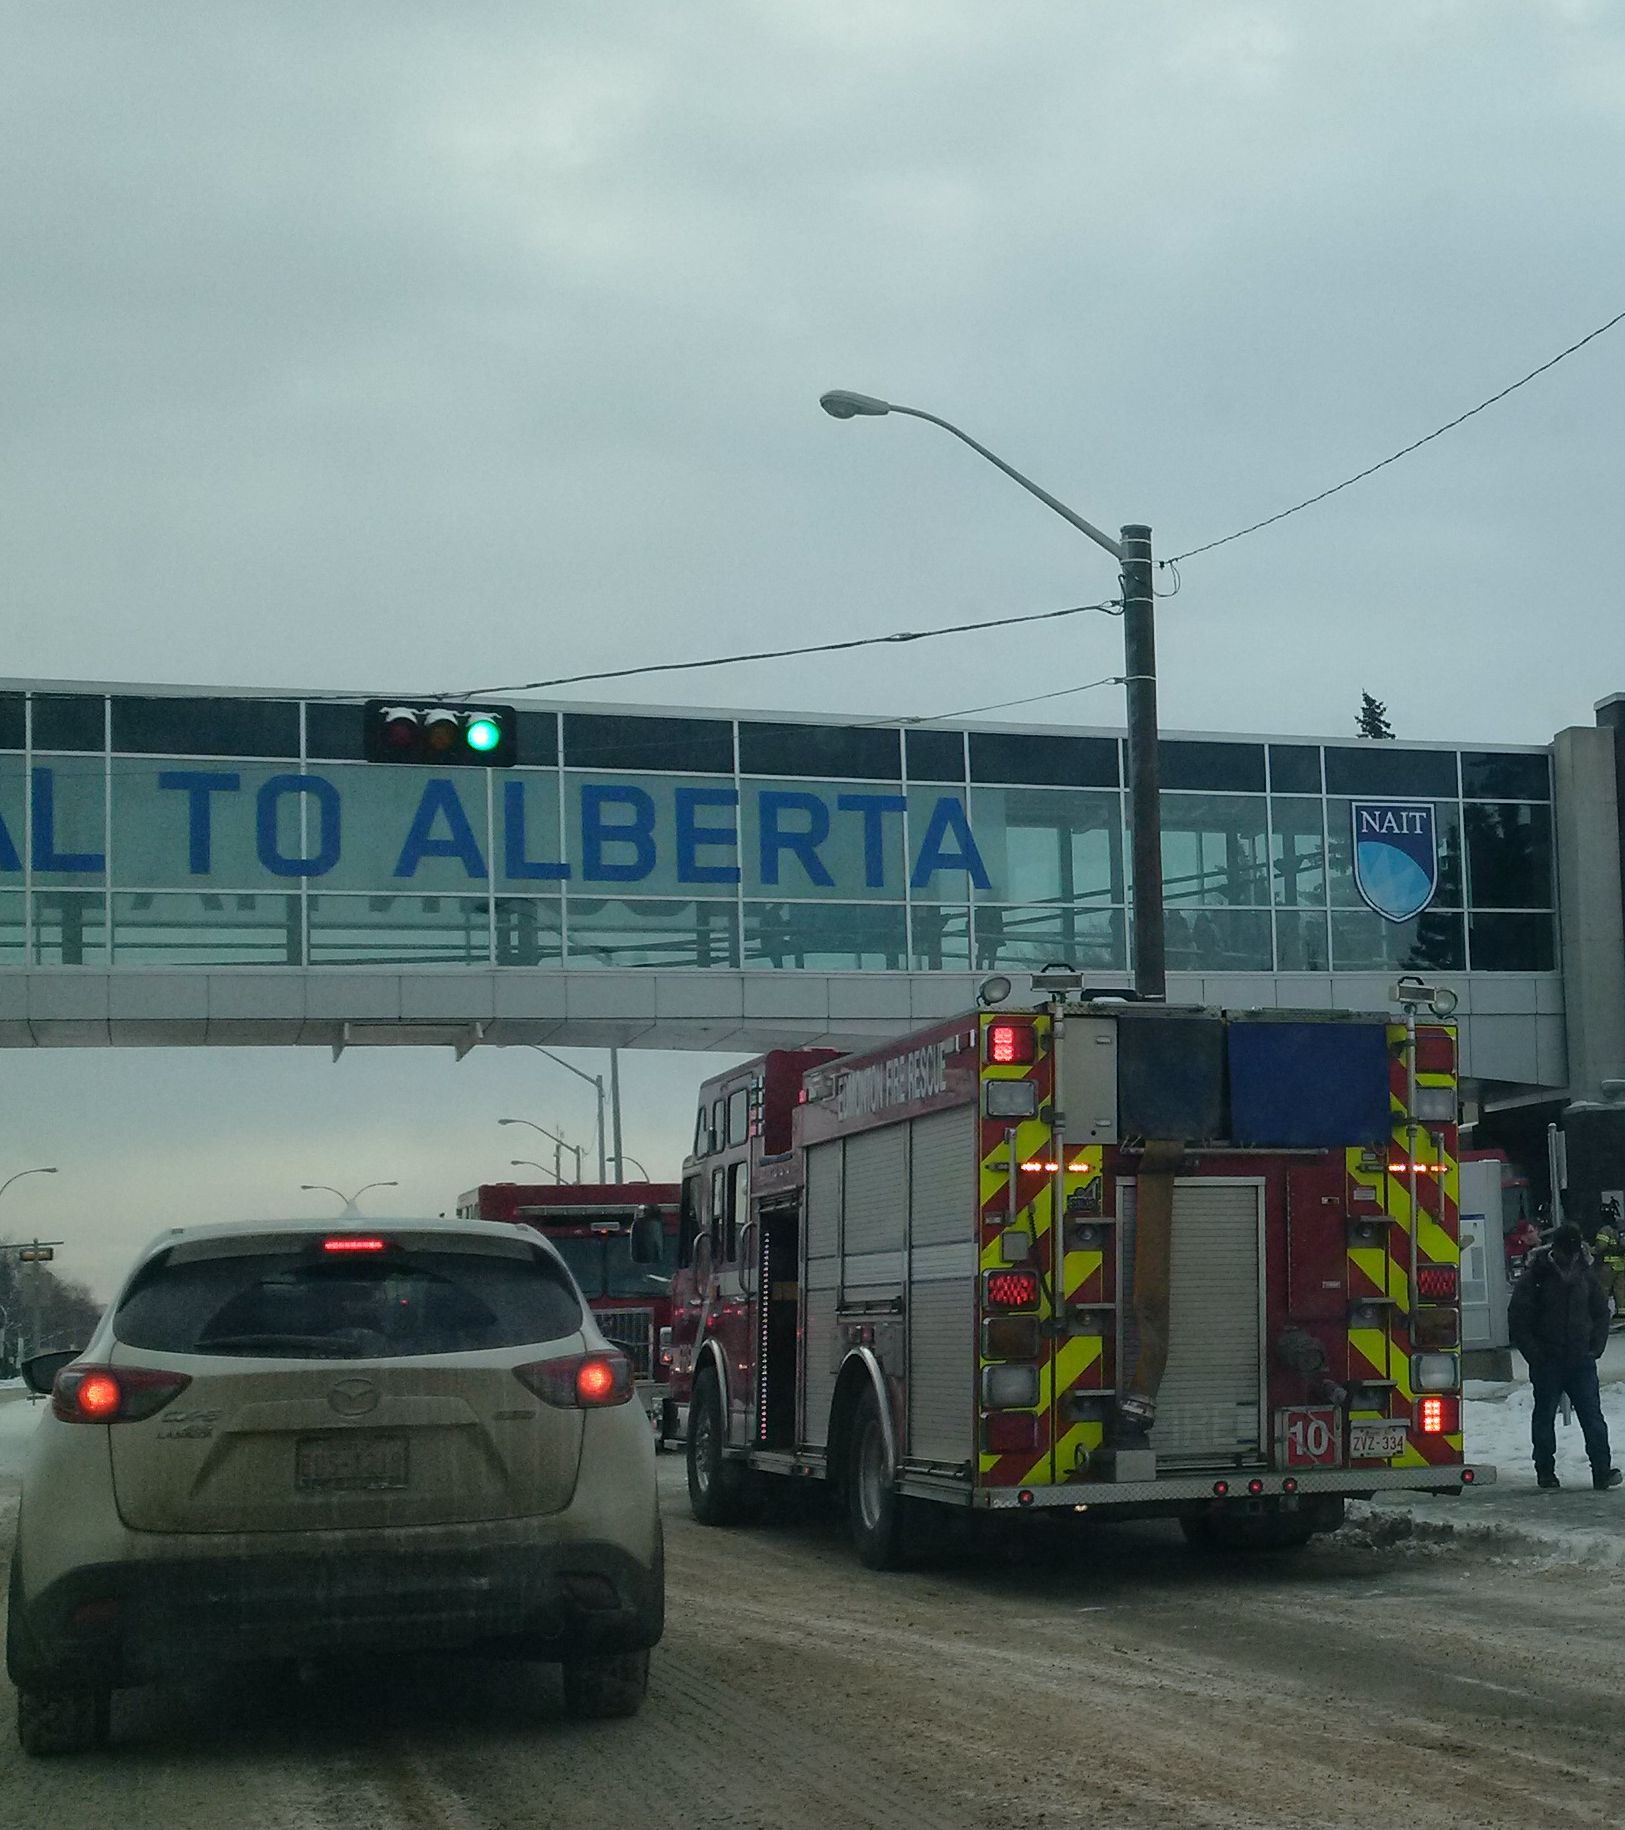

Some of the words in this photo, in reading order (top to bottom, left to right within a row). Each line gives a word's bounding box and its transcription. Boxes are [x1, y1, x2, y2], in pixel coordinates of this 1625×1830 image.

[0, 767, 105, 873] L
[158, 771, 341, 877] TO
[394, 778, 992, 889] ALBERTA
[1360, 810, 1427, 834] NAIT
[908, 1042, 947, 1100] RESCUE
[1290, 1419, 1329, 1456] 10
